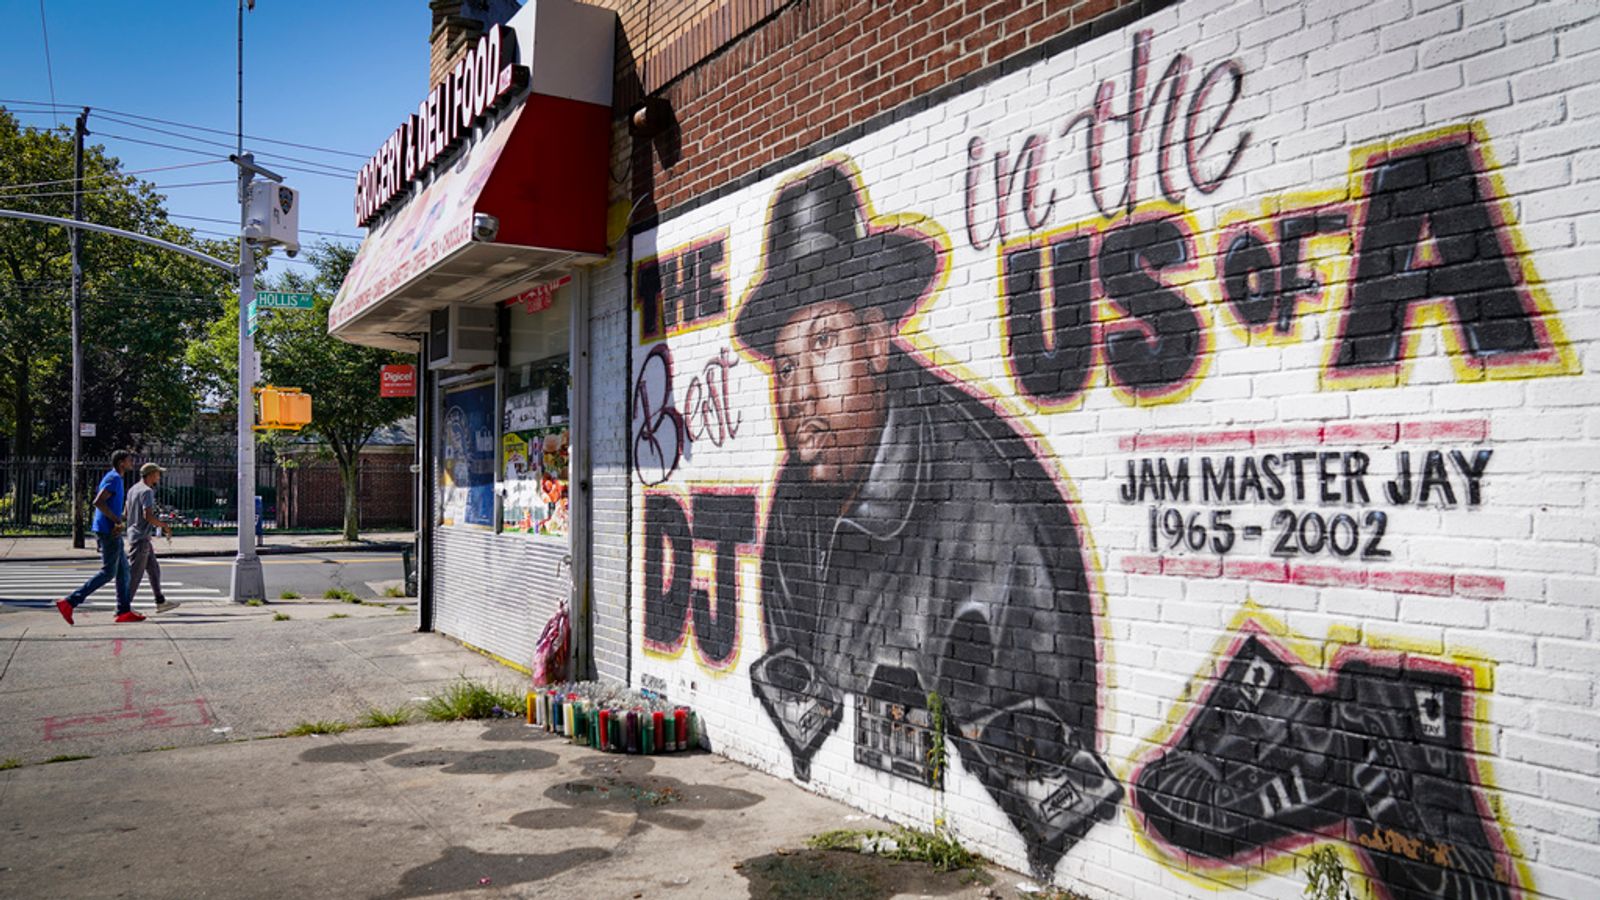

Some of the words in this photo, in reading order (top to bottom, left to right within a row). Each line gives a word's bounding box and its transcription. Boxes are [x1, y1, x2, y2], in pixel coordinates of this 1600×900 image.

[354, 123, 404, 227] GROCERY
[405, 113, 416, 182] &
[418, 74, 450, 171] DELI
[453, 23, 500, 138] FOOD
[964, 134, 1055, 252] in
[1060, 28, 1254, 216] the
[259, 293, 298, 306] HOLLIS
[635, 232, 728, 342] THE
[1003, 212, 1206, 404] US
[1328, 133, 1552, 375] A
[384, 371, 413, 382] Digicel
[633, 343, 742, 487] Best
[1120, 456, 1190, 504] JAM
[1201, 450, 1372, 505] MASTER
[1384, 449, 1492, 510] JAY
[643, 488, 758, 667] DJ
